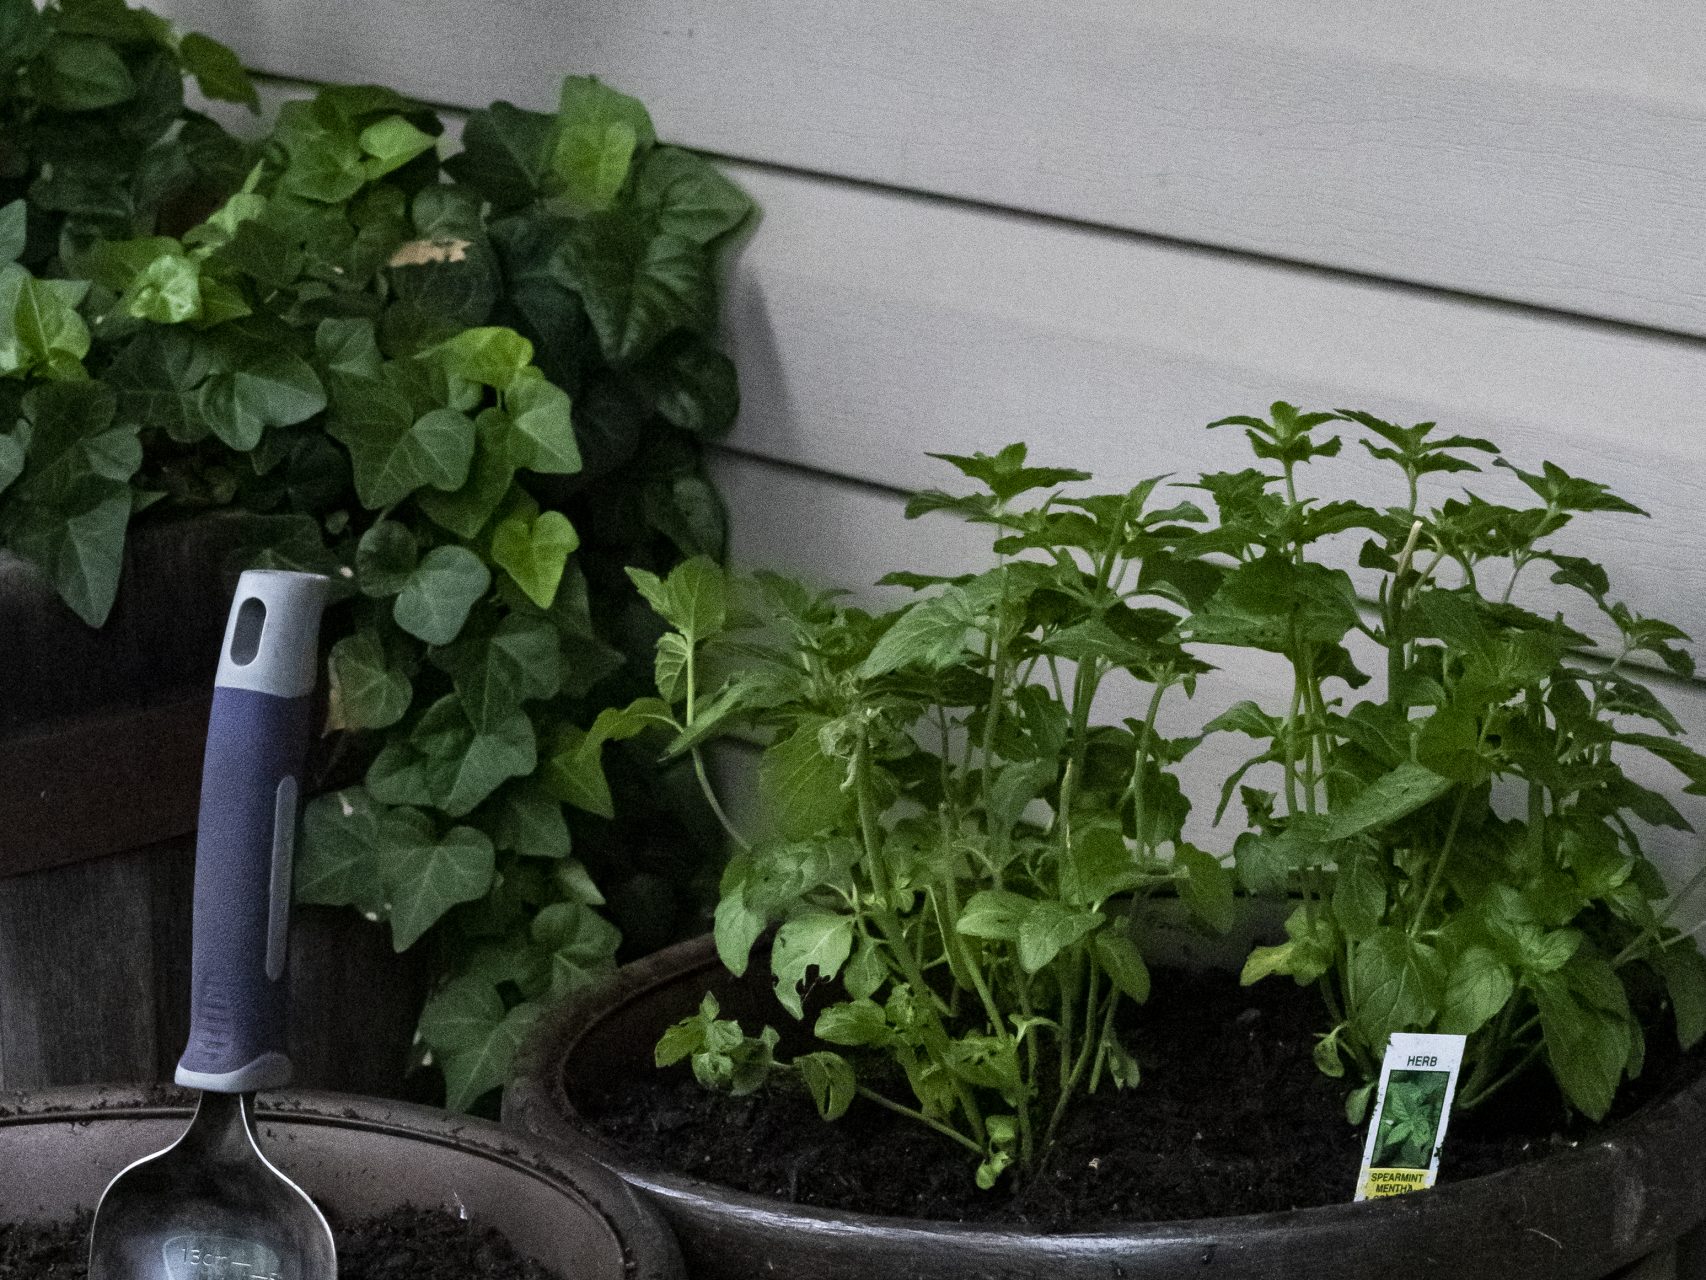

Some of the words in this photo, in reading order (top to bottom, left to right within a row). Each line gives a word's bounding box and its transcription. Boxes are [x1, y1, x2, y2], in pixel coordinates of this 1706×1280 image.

[1407, 1055, 1438, 1067] HERB
[1371, 1172, 1424, 1183] SPEARMINT
[1375, 1184, 1413, 1193] MENTHA
